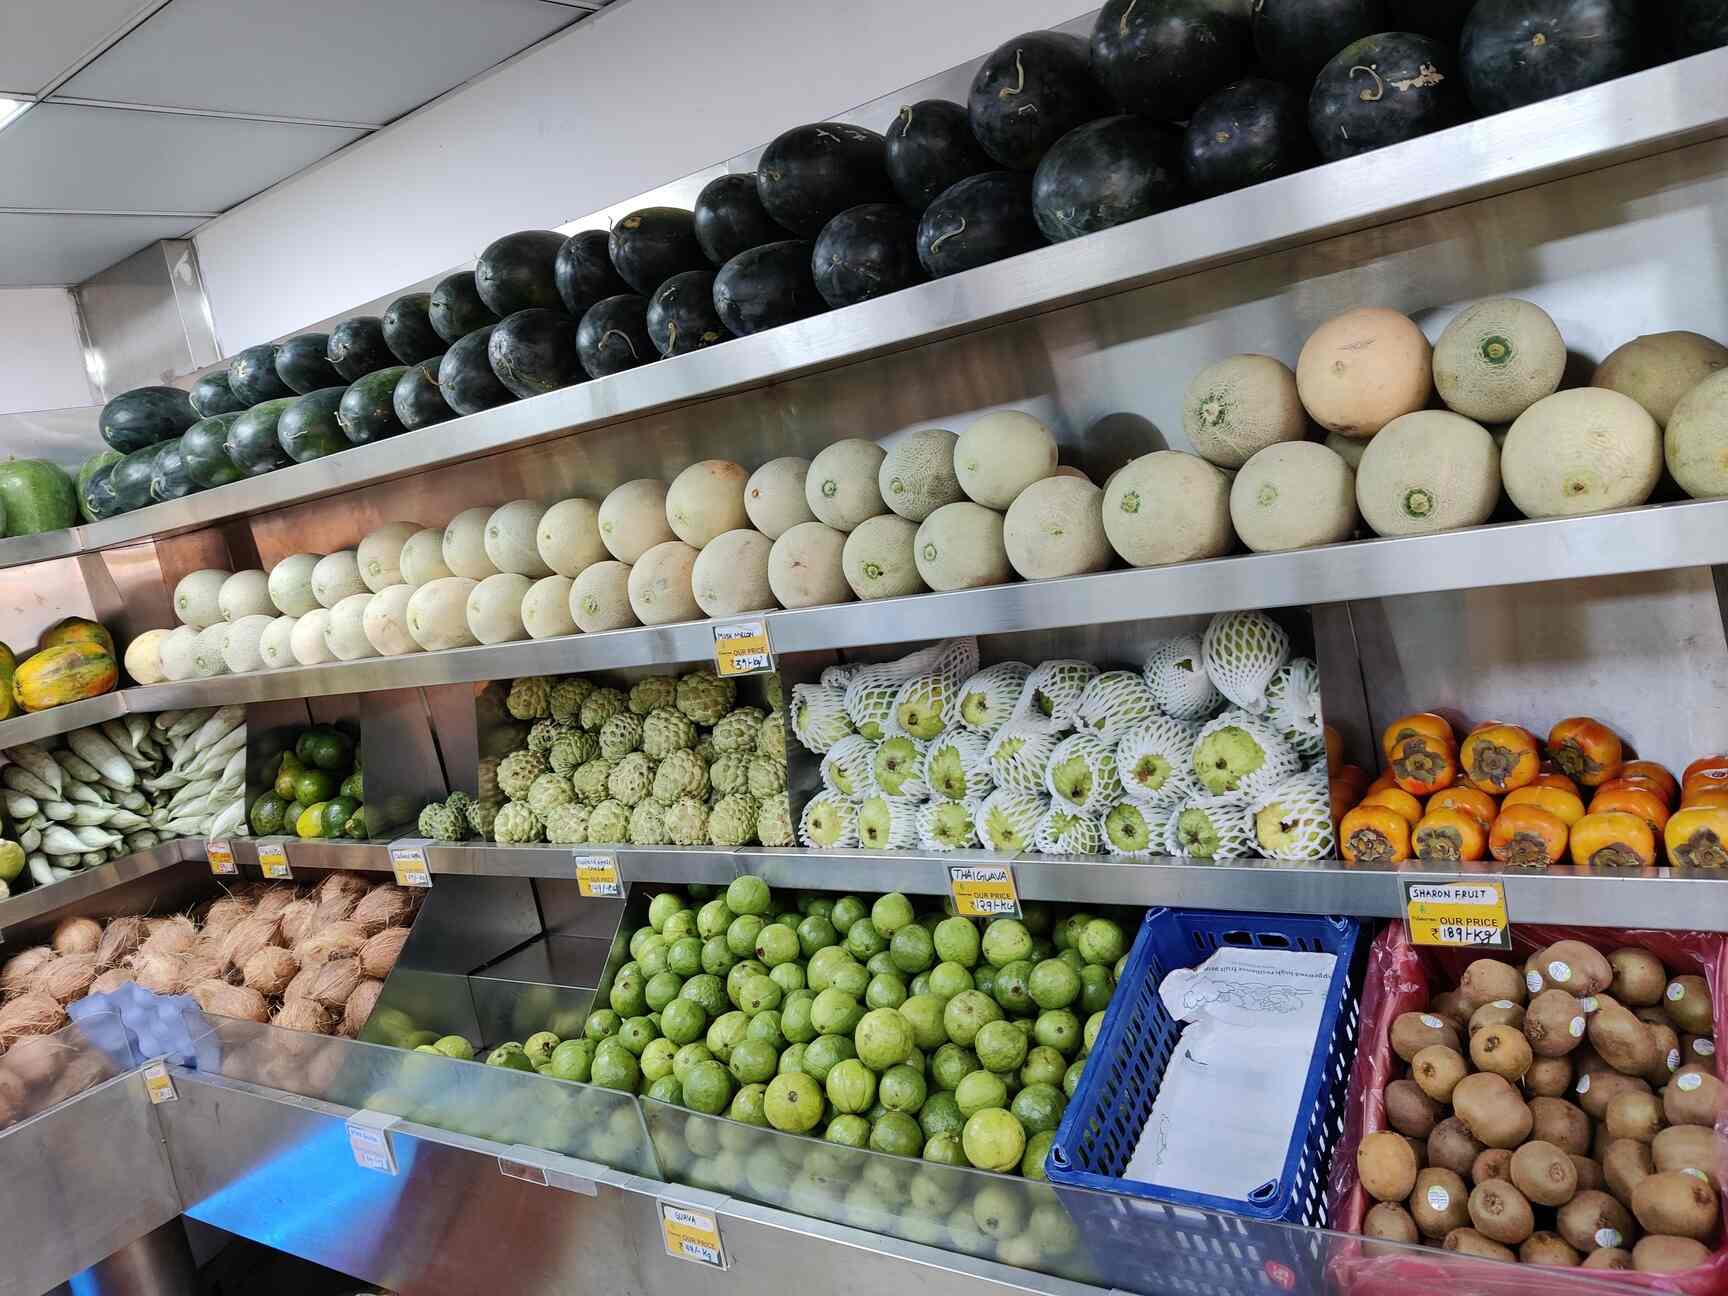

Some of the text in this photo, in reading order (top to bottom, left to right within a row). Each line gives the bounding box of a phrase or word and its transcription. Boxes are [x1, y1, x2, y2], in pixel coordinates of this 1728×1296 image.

[748, 647, 764, 655] PRICE
[953, 869, 1008, 881] THAI GUAVA
[1413, 888, 1488, 898] SHARON FRUIT
[1440, 916, 1463, 926] OUR
[1466, 917, 1498, 928] PRICE
[674, 1211, 696, 1224] GUAVA
[682, 1234, 695, 1243] OUR
[696, 1239, 714, 1248] PRICE
